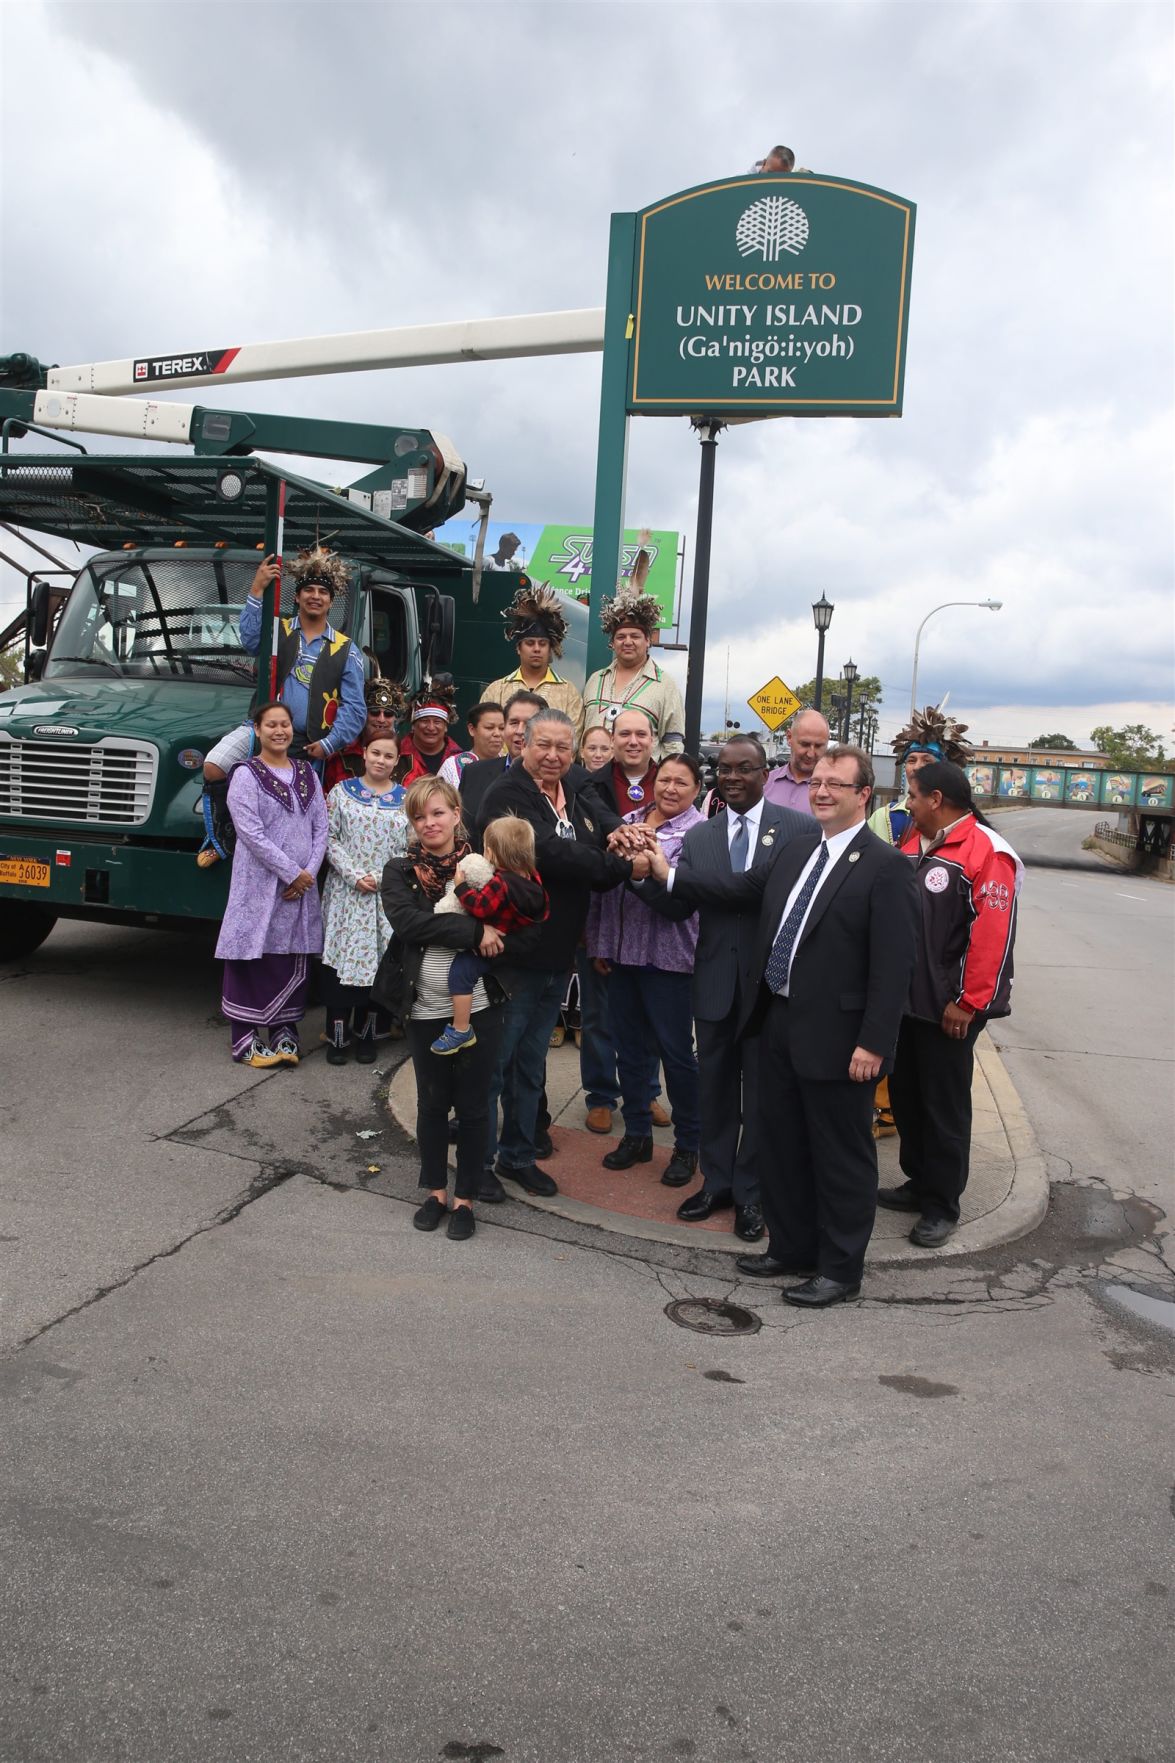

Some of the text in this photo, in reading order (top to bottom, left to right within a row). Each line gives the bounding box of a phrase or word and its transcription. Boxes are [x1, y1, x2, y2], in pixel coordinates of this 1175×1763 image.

[705, 272, 836, 291] WELCOME TO
[676, 304, 863, 327] UNITY ISLAND
[679, 334, 855, 363] (Ga'nigö:i:yoh)
[152, 356, 204, 376] TEREX
[732, 366, 797, 388] PARK
[756, 695, 793, 705] ONE LANE
[761, 706, 787, 715] BRIDGE
[25, 864, 48, 881] 6039
